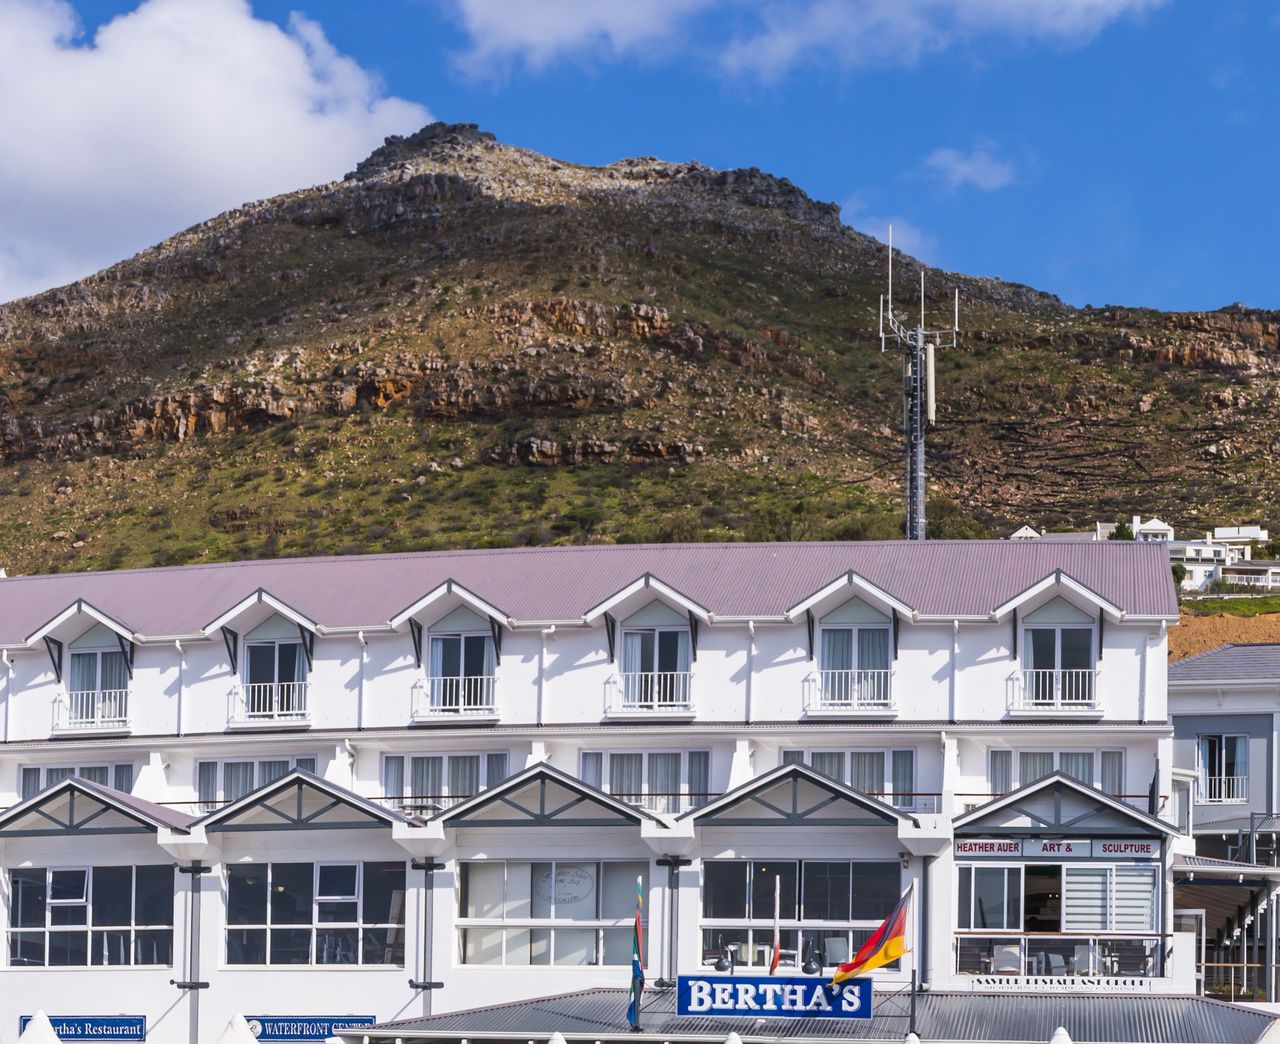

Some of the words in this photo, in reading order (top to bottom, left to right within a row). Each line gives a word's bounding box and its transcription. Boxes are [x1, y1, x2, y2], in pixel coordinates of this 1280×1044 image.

[956, 843, 995, 852] HEATHER
[997, 843, 1019, 852] AUER
[1041, 843, 1061, 852] ART
[1065, 843, 1073, 852] &
[1102, 844, 1151, 853] SCULPTURE
[687, 980, 862, 1012] BERTHA'S
[52, 1023, 82, 1035] rtha's
[84, 1023, 141, 1035] Restaurant
[264, 1022, 330, 1035] WATERFRONT
